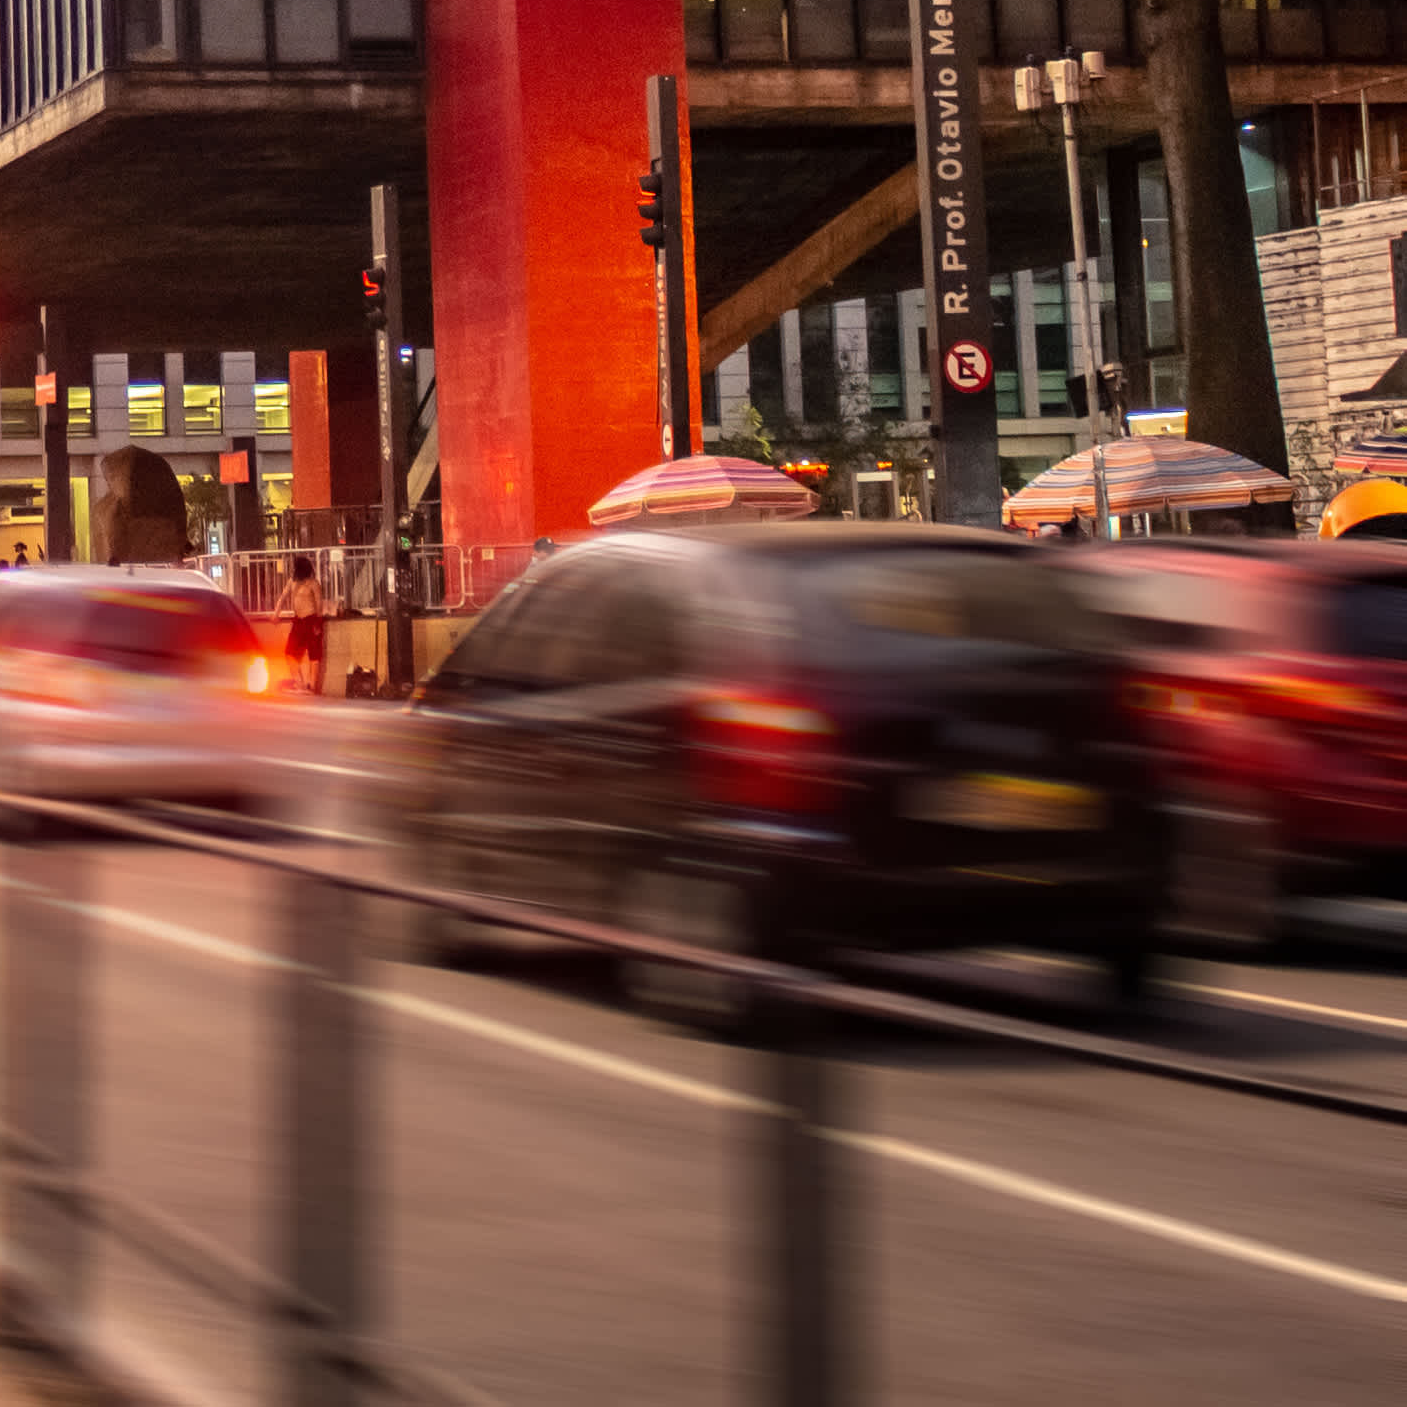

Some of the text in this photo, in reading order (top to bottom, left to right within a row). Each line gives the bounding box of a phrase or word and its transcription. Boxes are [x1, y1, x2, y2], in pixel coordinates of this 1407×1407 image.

[933, 67, 964, 181] Otavio
[939, 191, 968, 272] Prof.
[943, 284, 970, 314] R.
